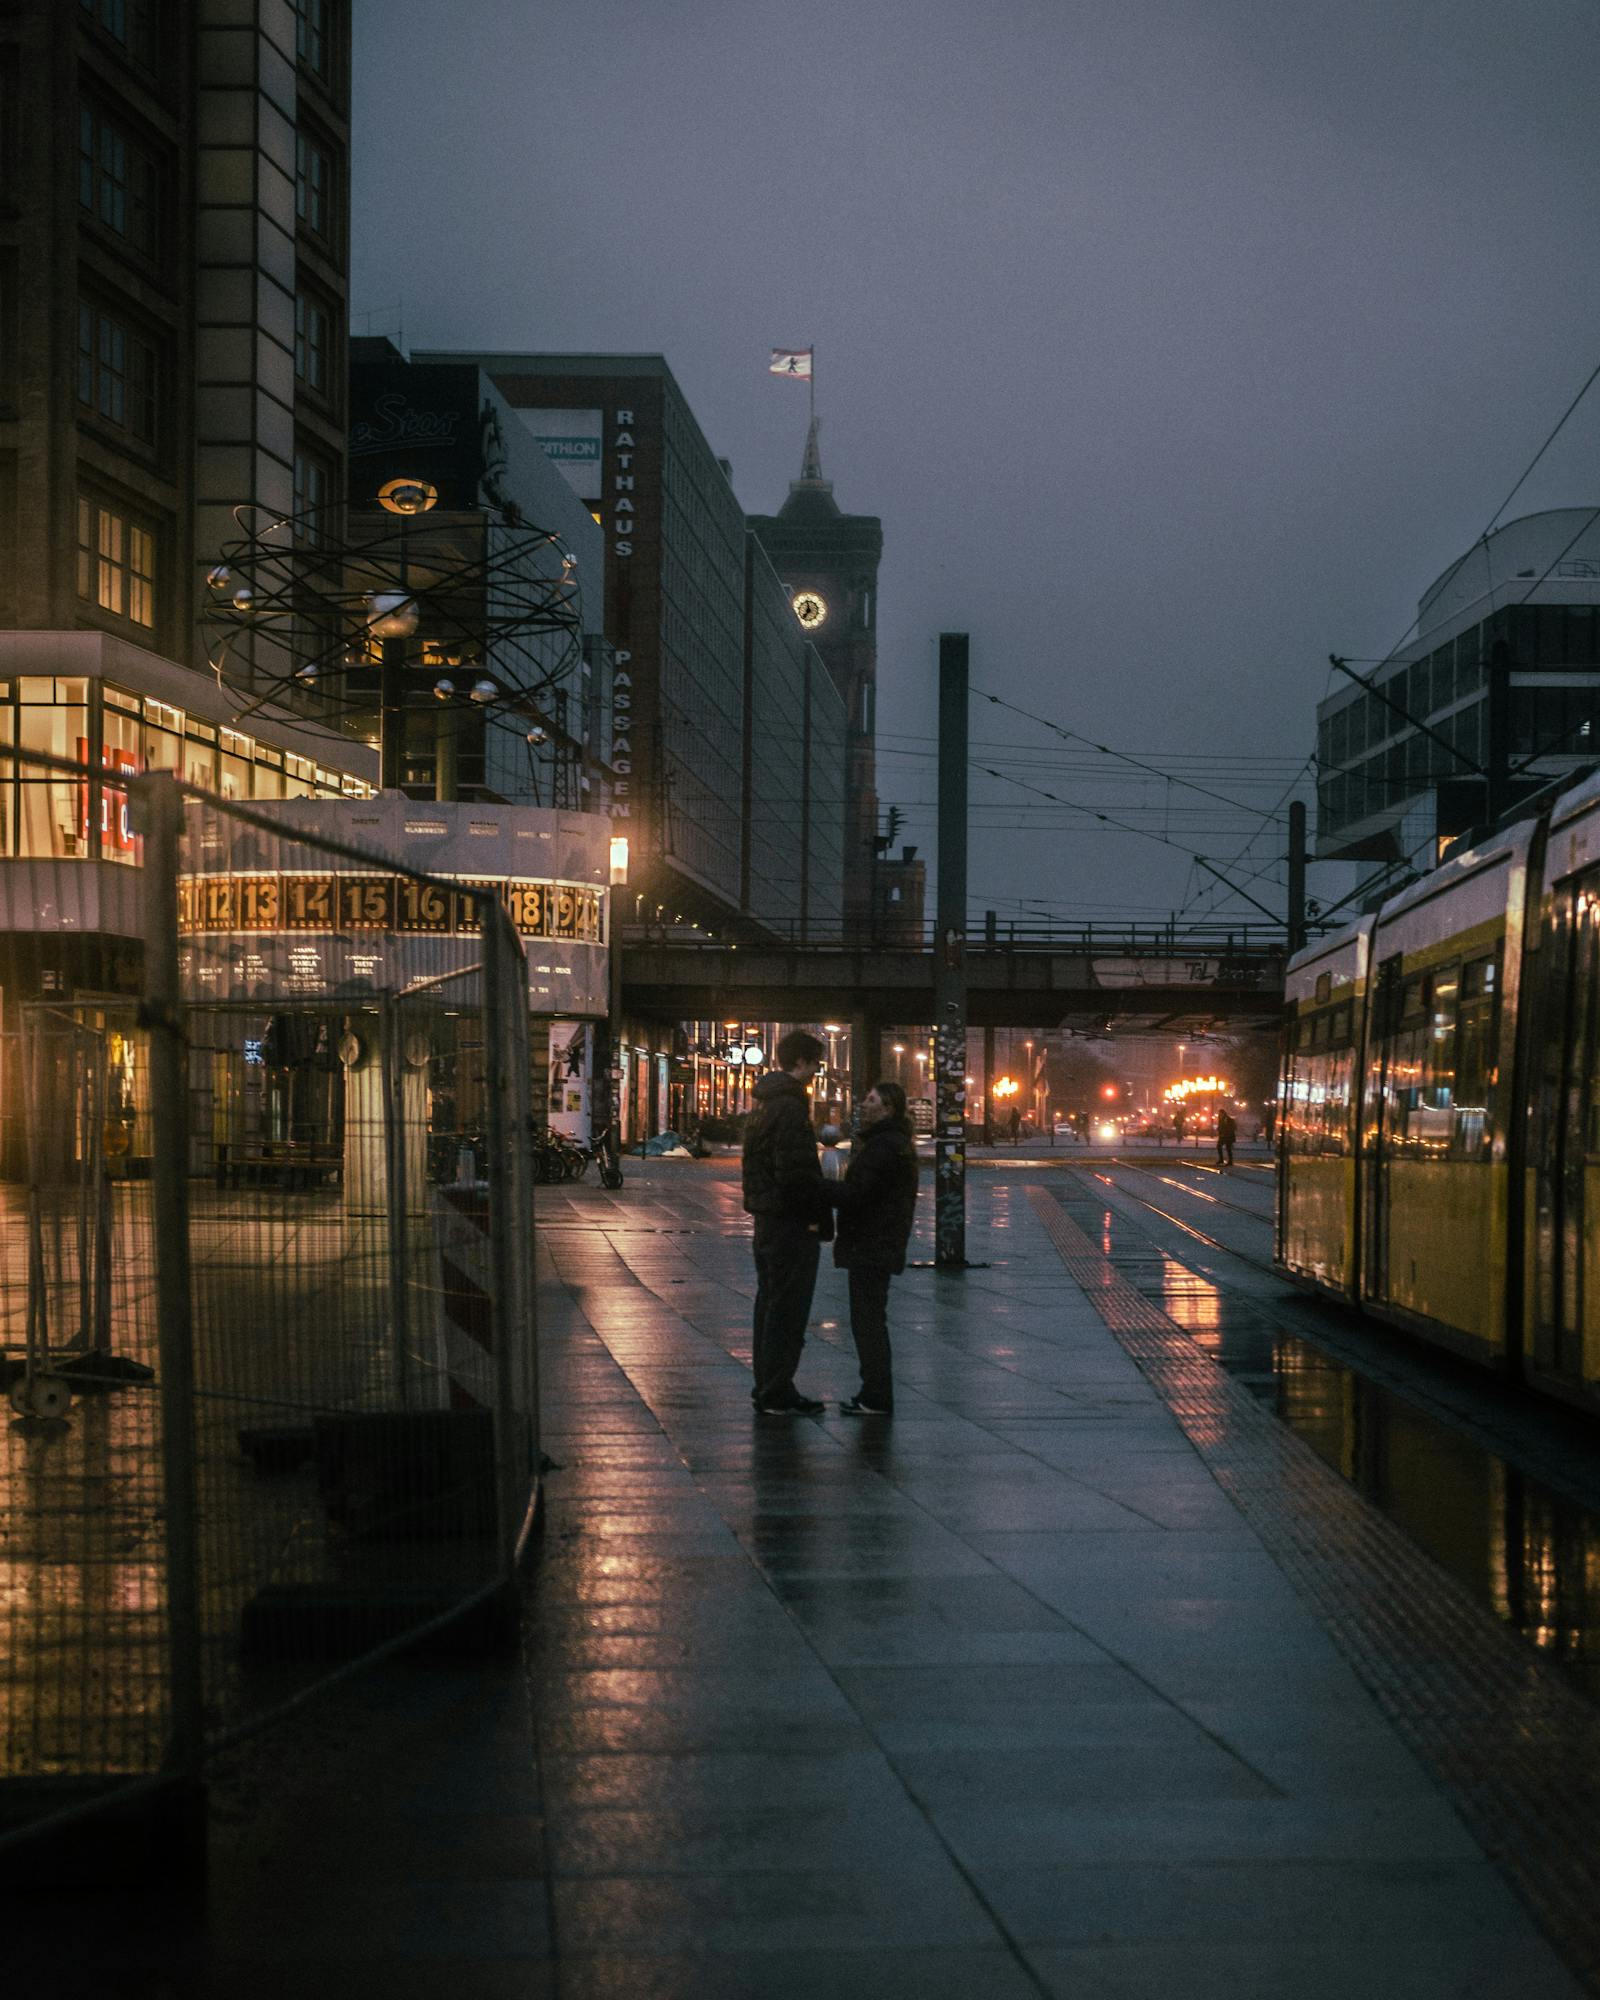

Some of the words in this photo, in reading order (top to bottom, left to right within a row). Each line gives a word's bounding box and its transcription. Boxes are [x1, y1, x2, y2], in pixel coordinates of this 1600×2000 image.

[614, 409, 635, 557] RATHAUS
[612, 650, 632, 817] PASSAGEN
[207, 885, 231, 919] 12
[244, 883, 279, 919] 13
[293, 883, 329, 919] 14
[345, 885, 388, 920] 15
[403, 883, 446, 921] 16
[509, 890, 541, 927] 18
[550, 893, 575, 928] 19
